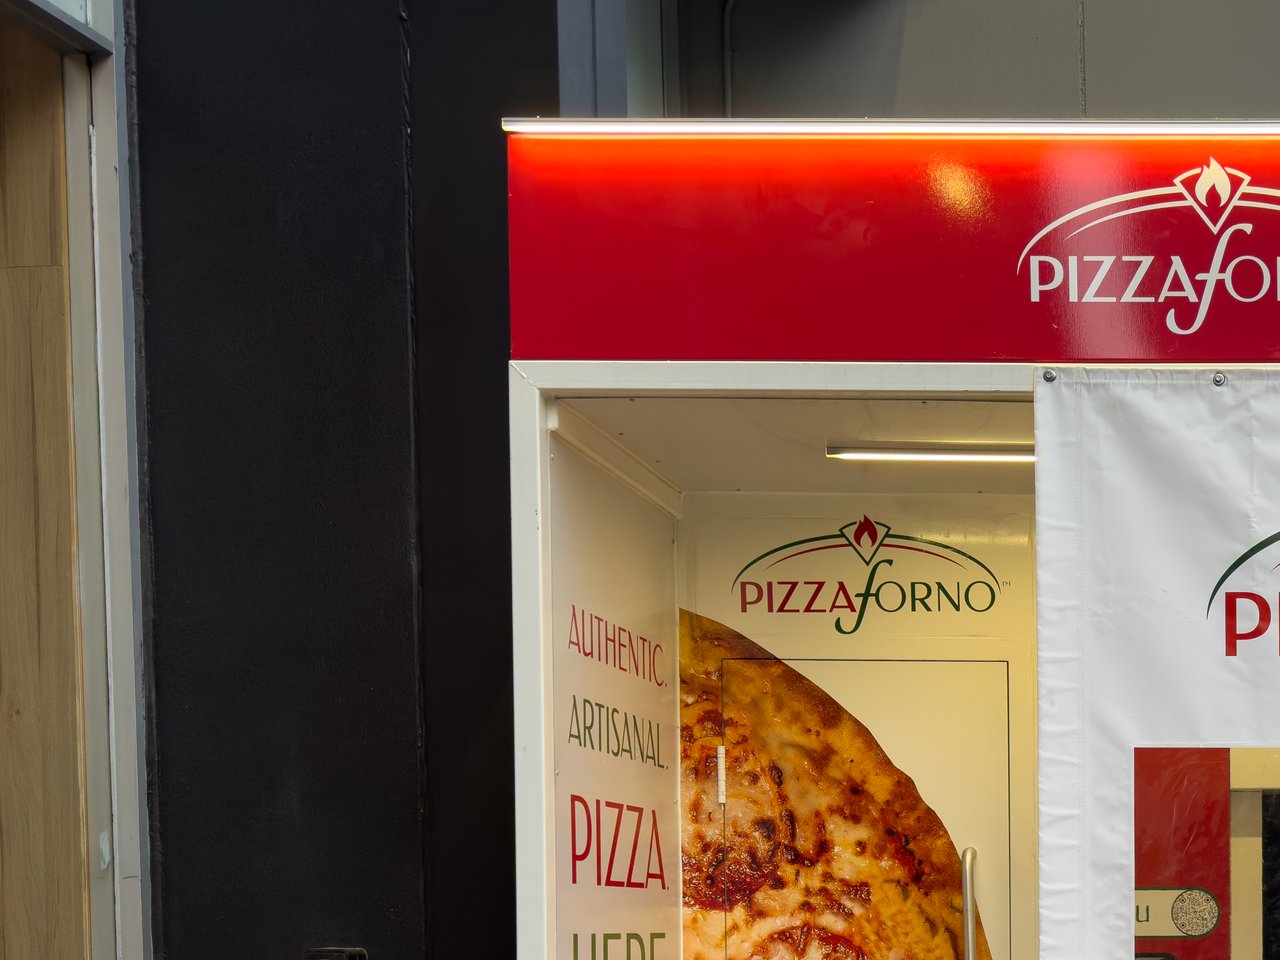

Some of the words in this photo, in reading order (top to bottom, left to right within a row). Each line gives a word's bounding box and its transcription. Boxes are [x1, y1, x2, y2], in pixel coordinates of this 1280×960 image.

[568, 604, 668, 688] AUTHENTIC.
[568, 694, 669, 770] ARTISANAL.
[570, 793, 670, 891] PIZZA.
